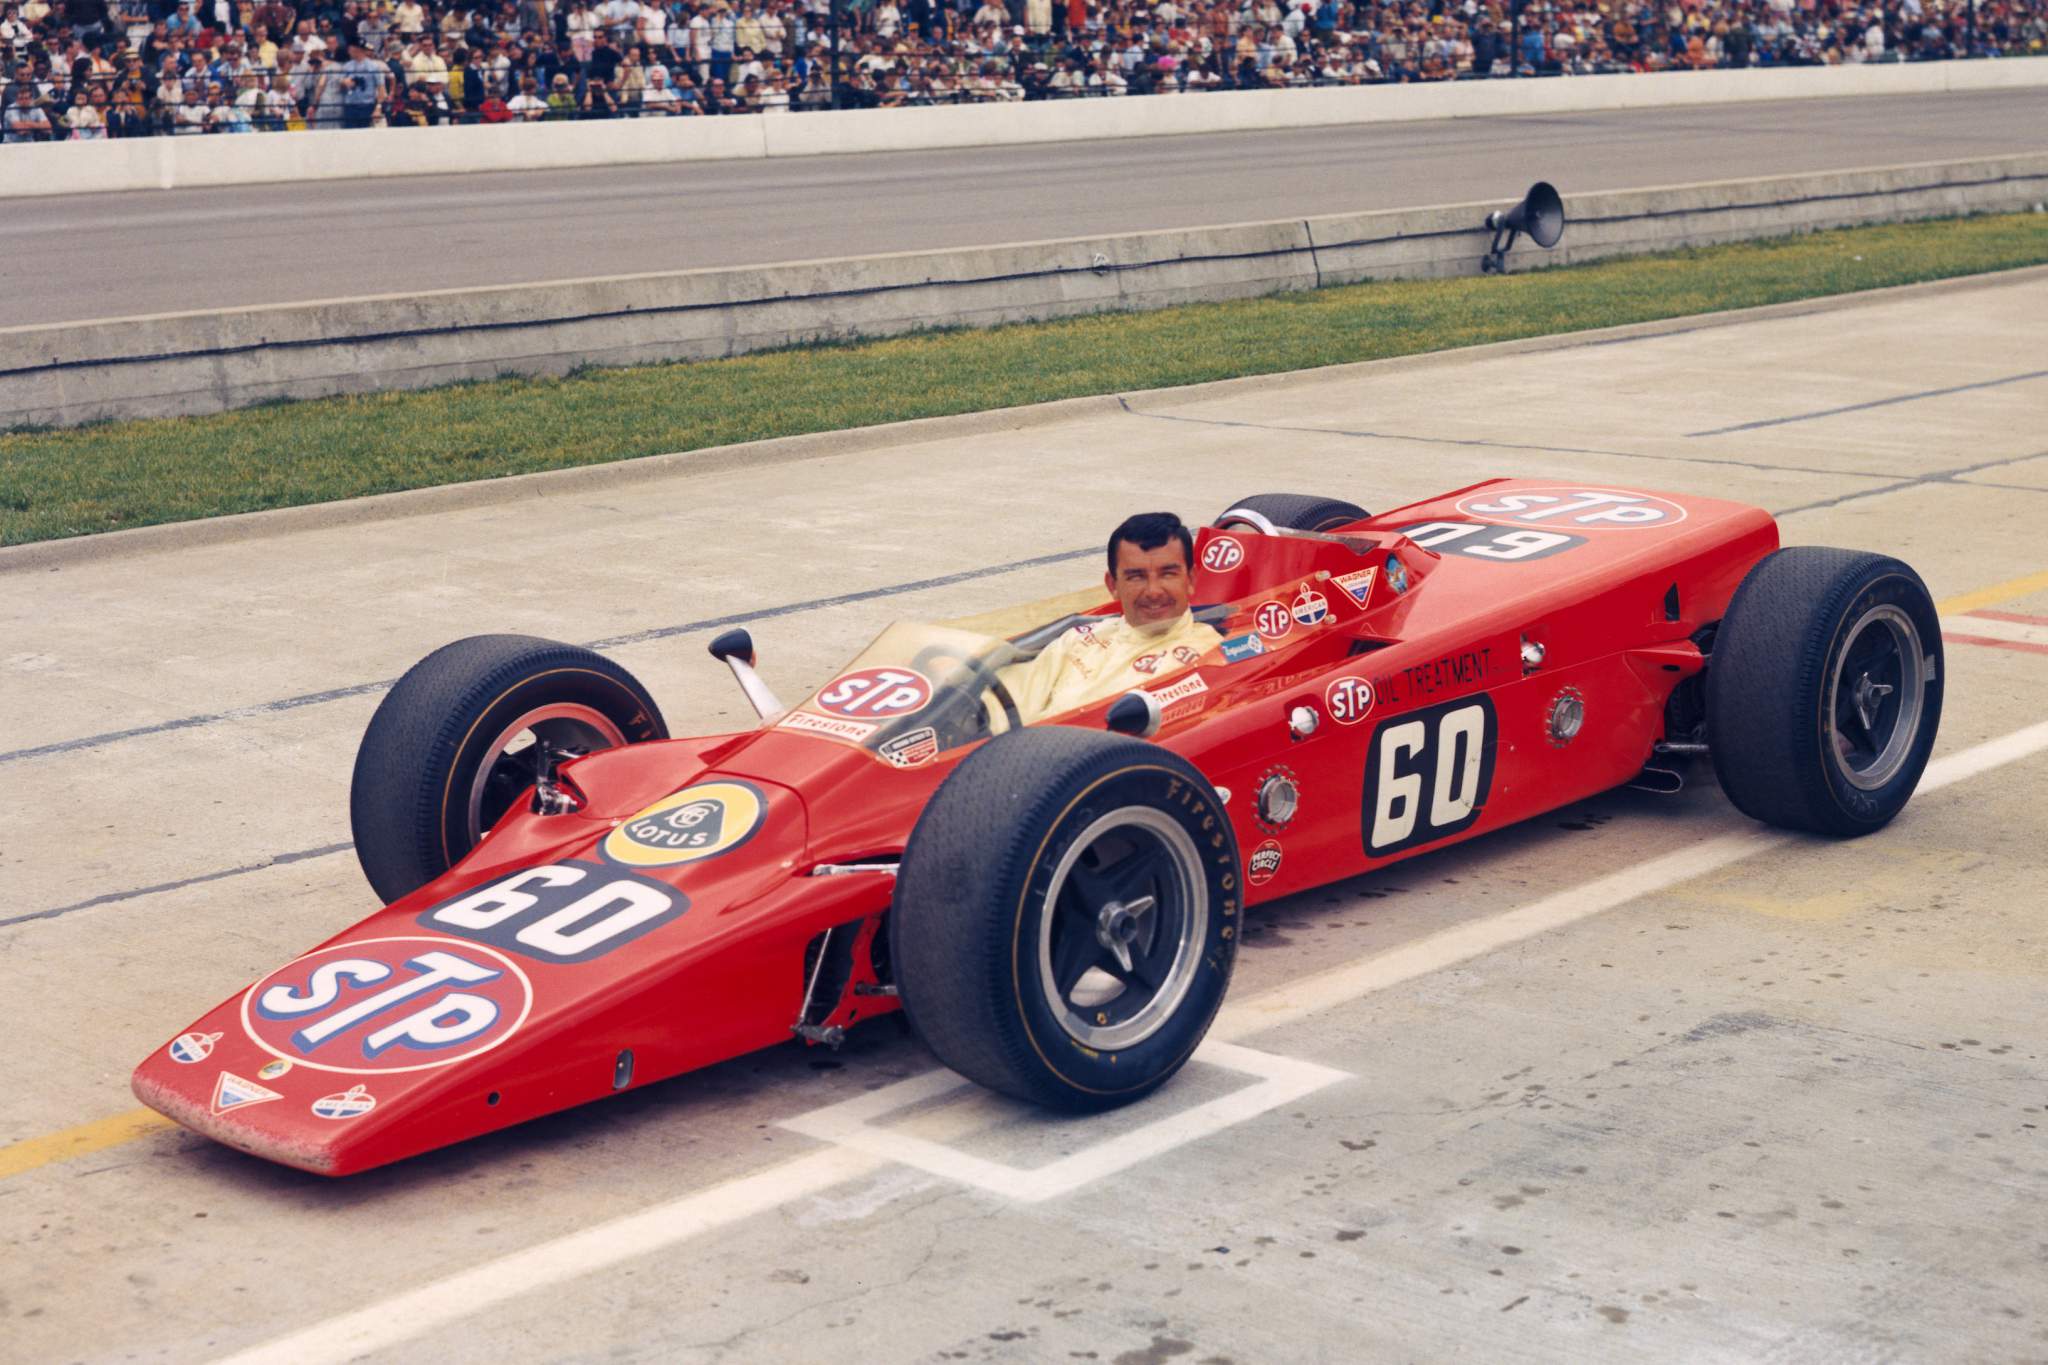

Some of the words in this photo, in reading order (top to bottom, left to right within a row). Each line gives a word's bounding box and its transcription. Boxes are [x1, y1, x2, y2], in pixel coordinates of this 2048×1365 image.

[1470, 491, 1665, 523] STP
[1204, 540, 1239, 567] STP
[1258, 605, 1289, 633] STP
[822, 671, 921, 712] STP
[1373, 673, 1400, 705] OIL
[1403, 648, 1491, 699] TREATMENT
[1332, 679, 1371, 718] STP
[1371, 705, 1485, 848] 60
[631, 819, 708, 846] LOTUS
[432, 864, 672, 956] 60
[256, 951, 504, 1059] STP
